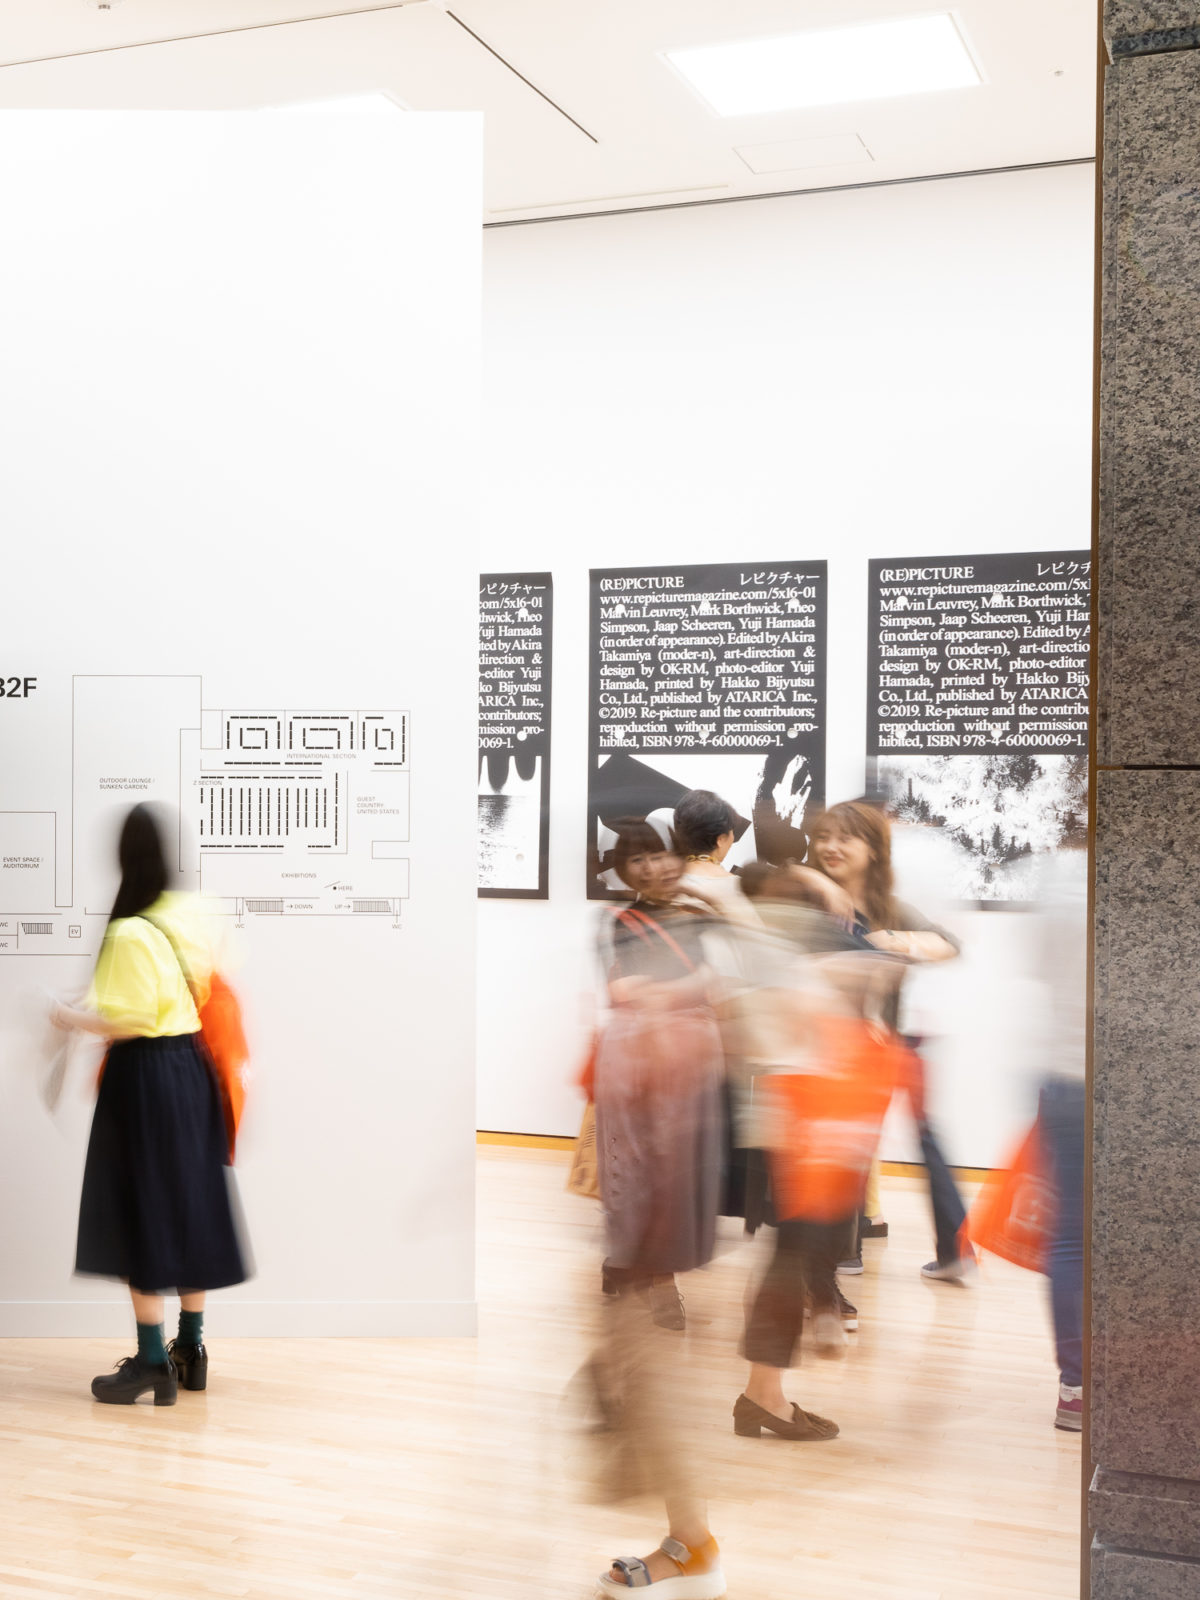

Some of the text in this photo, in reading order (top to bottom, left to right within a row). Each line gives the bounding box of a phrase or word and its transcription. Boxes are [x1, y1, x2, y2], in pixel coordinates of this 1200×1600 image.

[880, 566, 975, 583] (RE)PICTURE
[1036, 561, 1091, 576] レピクチ
[600, 576, 685, 592] (RE)PICTURE
[740, 571, 821, 586] レピクチャー
[600, 586, 817, 606] www.repicturemagazine.com/5x16-01
[880, 578, 1091, 599] www.repicturemagazine.com/5x1
[642, 606, 689, 620] Leuvrey,
[690, 604, 721, 617] Mark
[723, 602, 785, 616] Borthwick,
[785, 601, 817, 614] Theo
[927, 598, 979, 613] Leuvrey,
[981, 595, 1016, 609] Mark
[1017, 593, 1087, 608] Borthwick,
[480, 611, 543, 624] hwick, Theo
[600, 616, 816, 635] Simpson, Jaap Scheeren, Yuji Hamada
[880, 614, 936, 630] Simpson,
[939, 613, 968, 628] Jaap
[971, 611, 1032, 626] Scheeren,
[1035, 609, 1062, 626] Yuji
[498, 624, 543, 637] Hamada
[879, 629, 896, 645] (in
[897, 628, 930, 642] order
[930, 628, 945, 641] of
[944, 626, 1021, 644] appearance).
[1022, 625, 1064, 639] Edited
[1065, 624, 1082, 641] by
[480, 638, 543, 653] ted by Akira
[600, 631, 816, 650] (in order of appearance). Edited by Akira
[480, 652, 543, 665] direction &
[599, 645, 817, 664] Takamiya (moder-n), art-direction &
[878, 640, 1091, 660] Takamiya (moder-n), art-directio
[479, 666, 542, 681] -editor Yuji
[600, 660, 815, 679] design by OK-RM, photo-editor Yuji
[879, 656, 1087, 674] design by OK-RM, photo-editor
[498, 681, 543, 696] Bijyutsu
[600, 675, 815, 693] Hamada, printed by Hakko Bijyutsu
[879, 671, 1090, 689] Hamada, printed by Hakko Bijy
[479, 695, 545, 708] ARICA Inc.,
[599, 690, 818, 707] Co., Ltd., published by ATARICA Inc.,
[879, 687, 1089, 705] Co., Ltd., published by ATARICA
[479, 709, 543, 722] contributors;
[640, 706, 698, 721] Re-picture
[699, 706, 720, 718] and
[723, 705, 742, 718] the
[743, 705, 816, 719] contributors;
[925, 703, 990, 720] Re-picture
[991, 703, 1016, 716] and
[1018, 703, 1038, 716] the
[1041, 702, 1090, 716] contrib
[479, 723, 516, 735] mission
[600, 720, 819, 736] reproduction without permission pro-
[879, 718, 1088, 735] reproduction without permission
[600, 735, 640, 749] hibited,
[642, 735, 673, 747] ISBN
[879, 735, 924, 749] hibited,
[926, 735, 961, 747] ISBN
